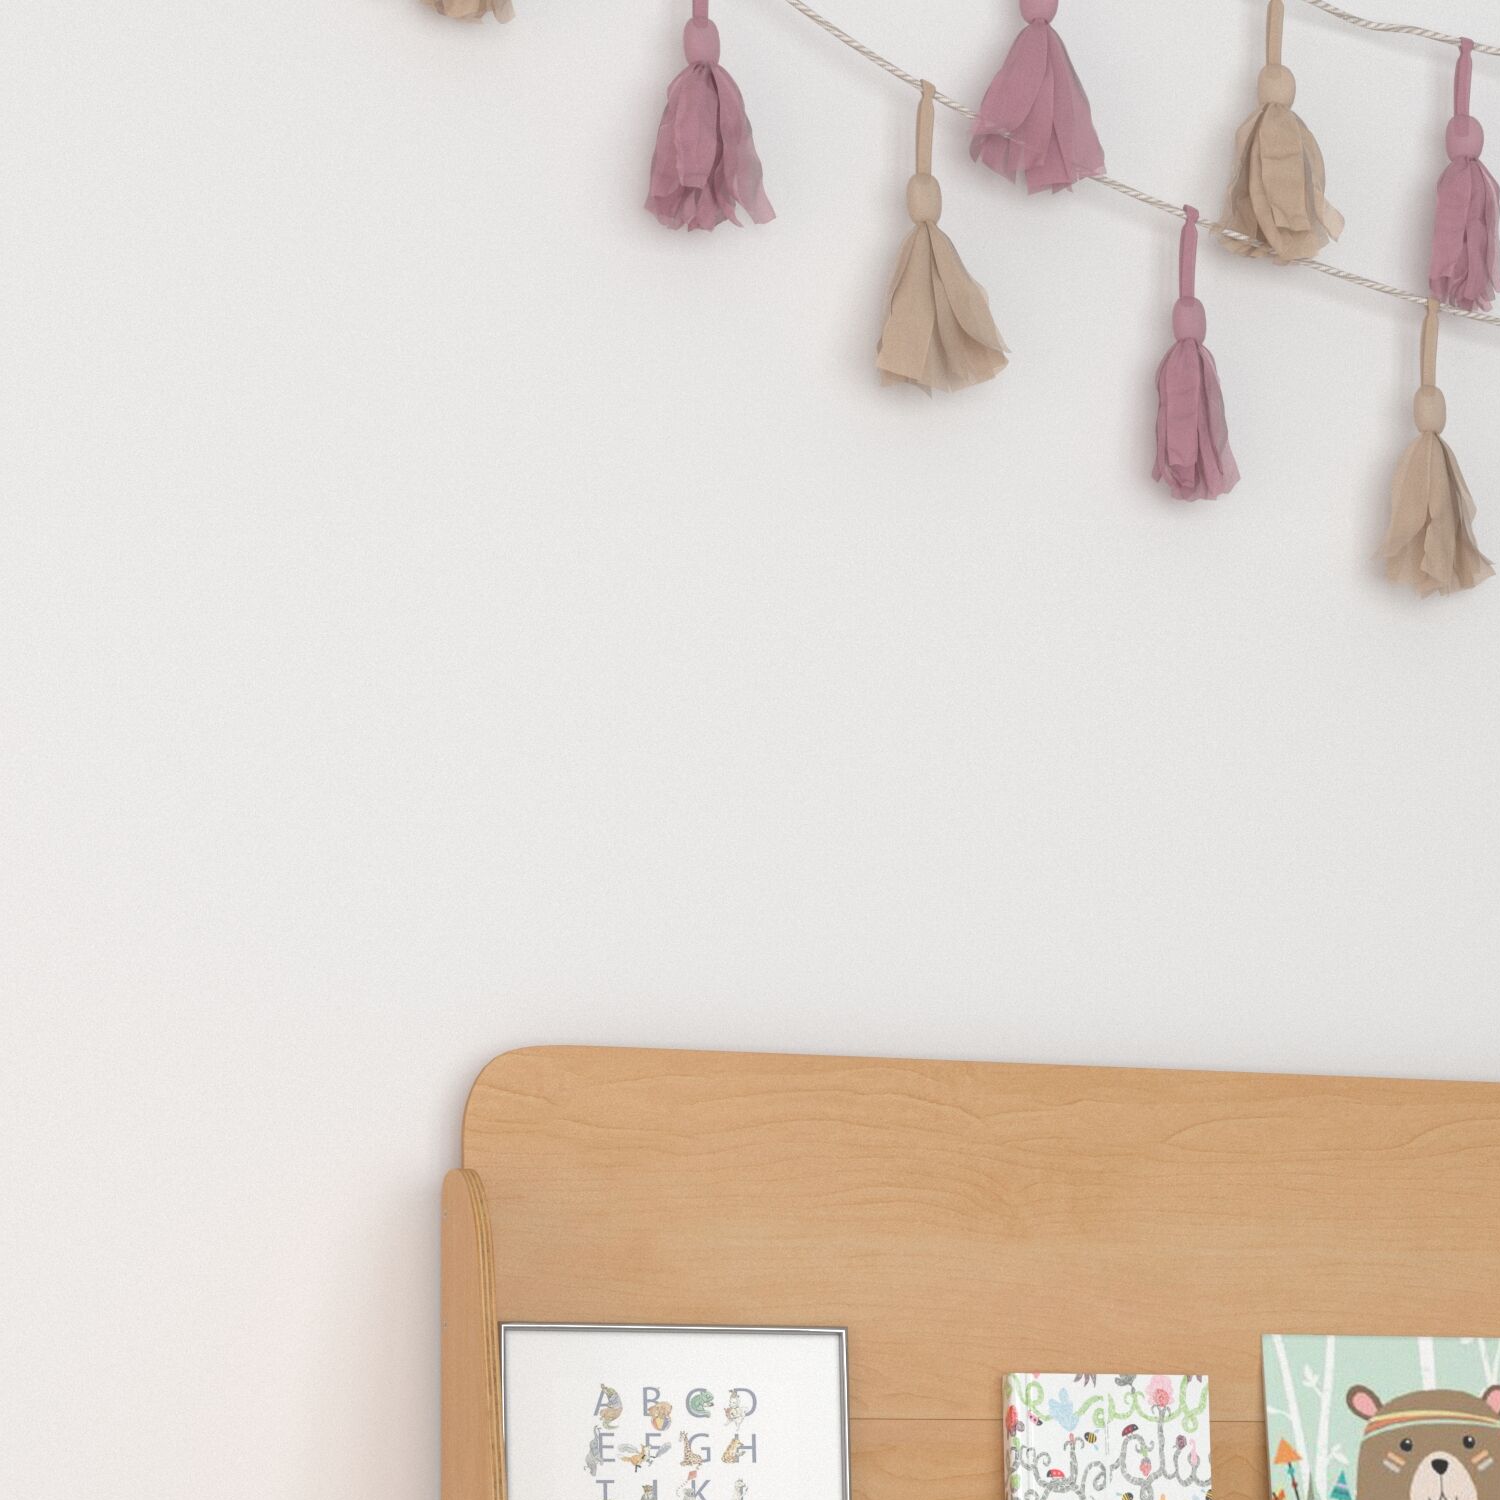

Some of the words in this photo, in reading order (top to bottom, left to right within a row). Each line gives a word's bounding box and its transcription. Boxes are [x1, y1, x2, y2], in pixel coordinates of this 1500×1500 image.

[593, 1386, 622, 1417] A
[642, 1386, 662, 1417] B
[686, 1387, 707, 1418] C
[732, 1388, 757, 1416] D
[598, 1433, 615, 1463] E
[689, 1433, 711, 1463] G
[735, 1433, 757, 1463] H
